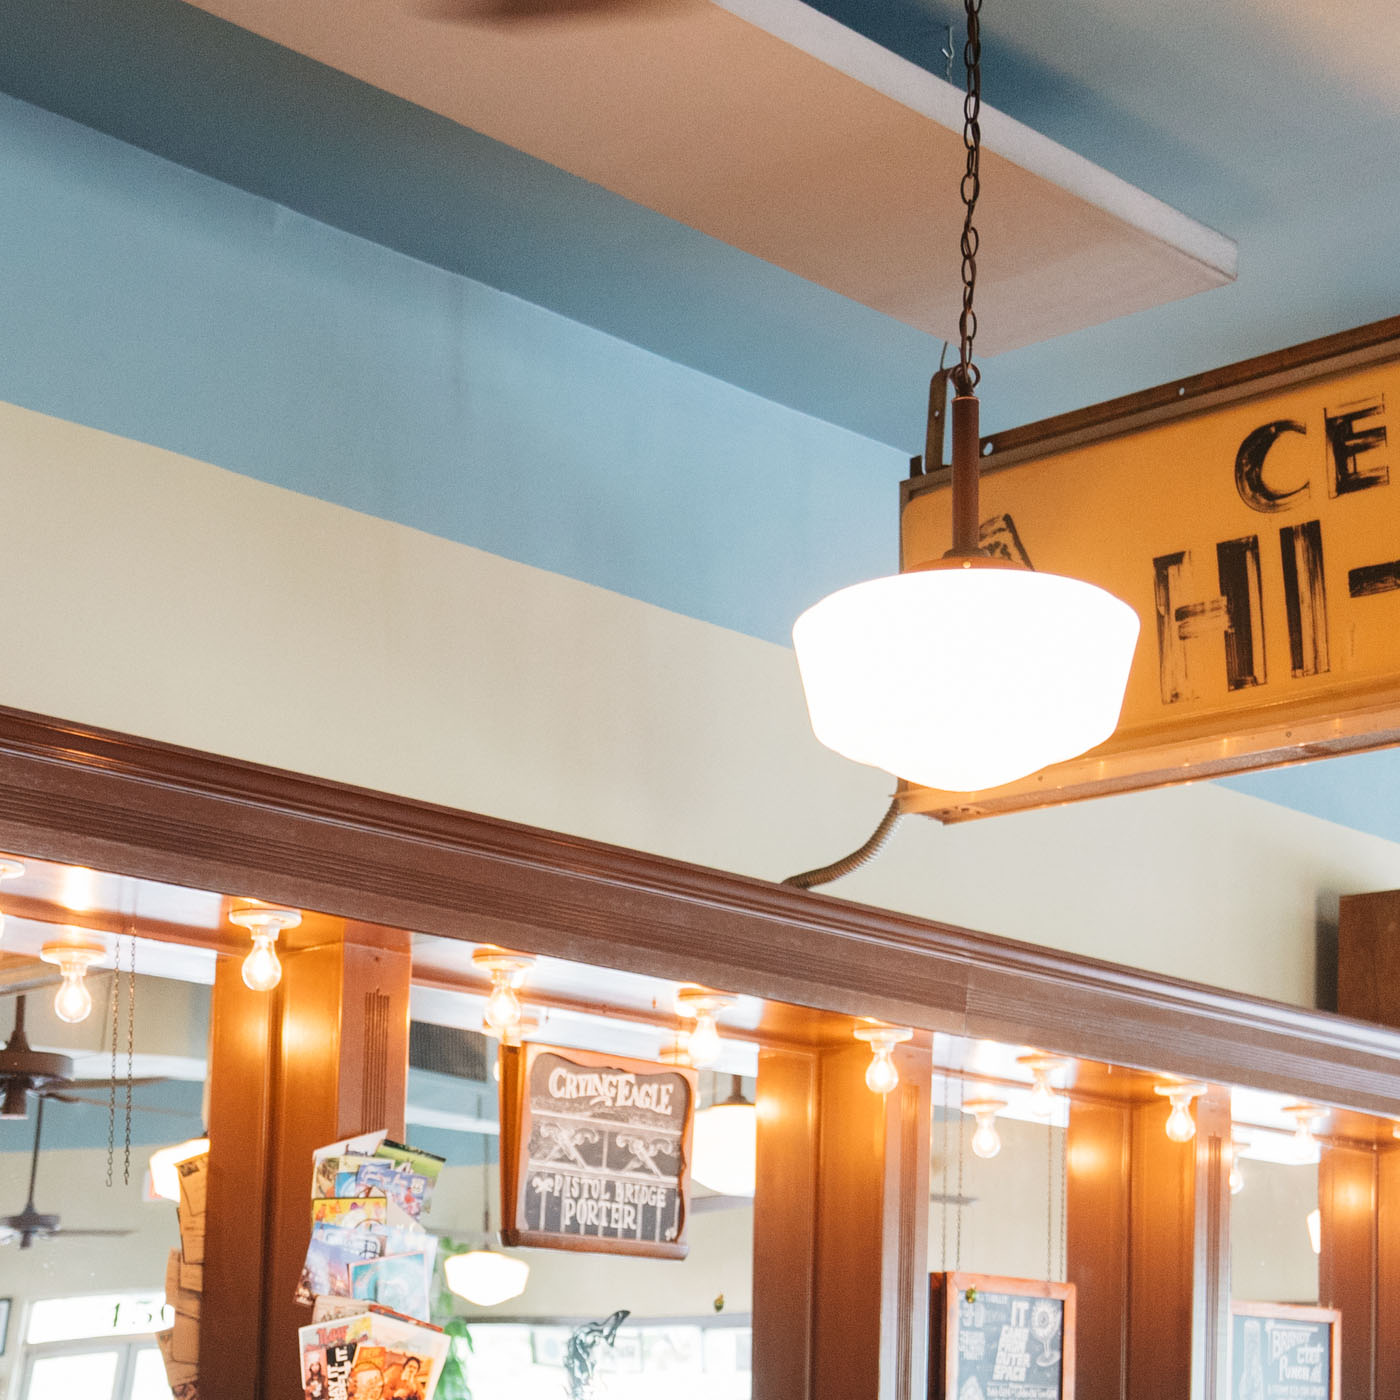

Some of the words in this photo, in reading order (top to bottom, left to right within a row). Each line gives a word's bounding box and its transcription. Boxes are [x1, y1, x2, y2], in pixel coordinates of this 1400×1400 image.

[549, 1067, 617, 1106] CRYING
[615, 1073, 673, 1115] EAGLE
[553, 1175, 610, 1201] PISTOL
[614, 1178, 668, 1208] BRIDGE
[564, 1200, 637, 1230] PORTER
